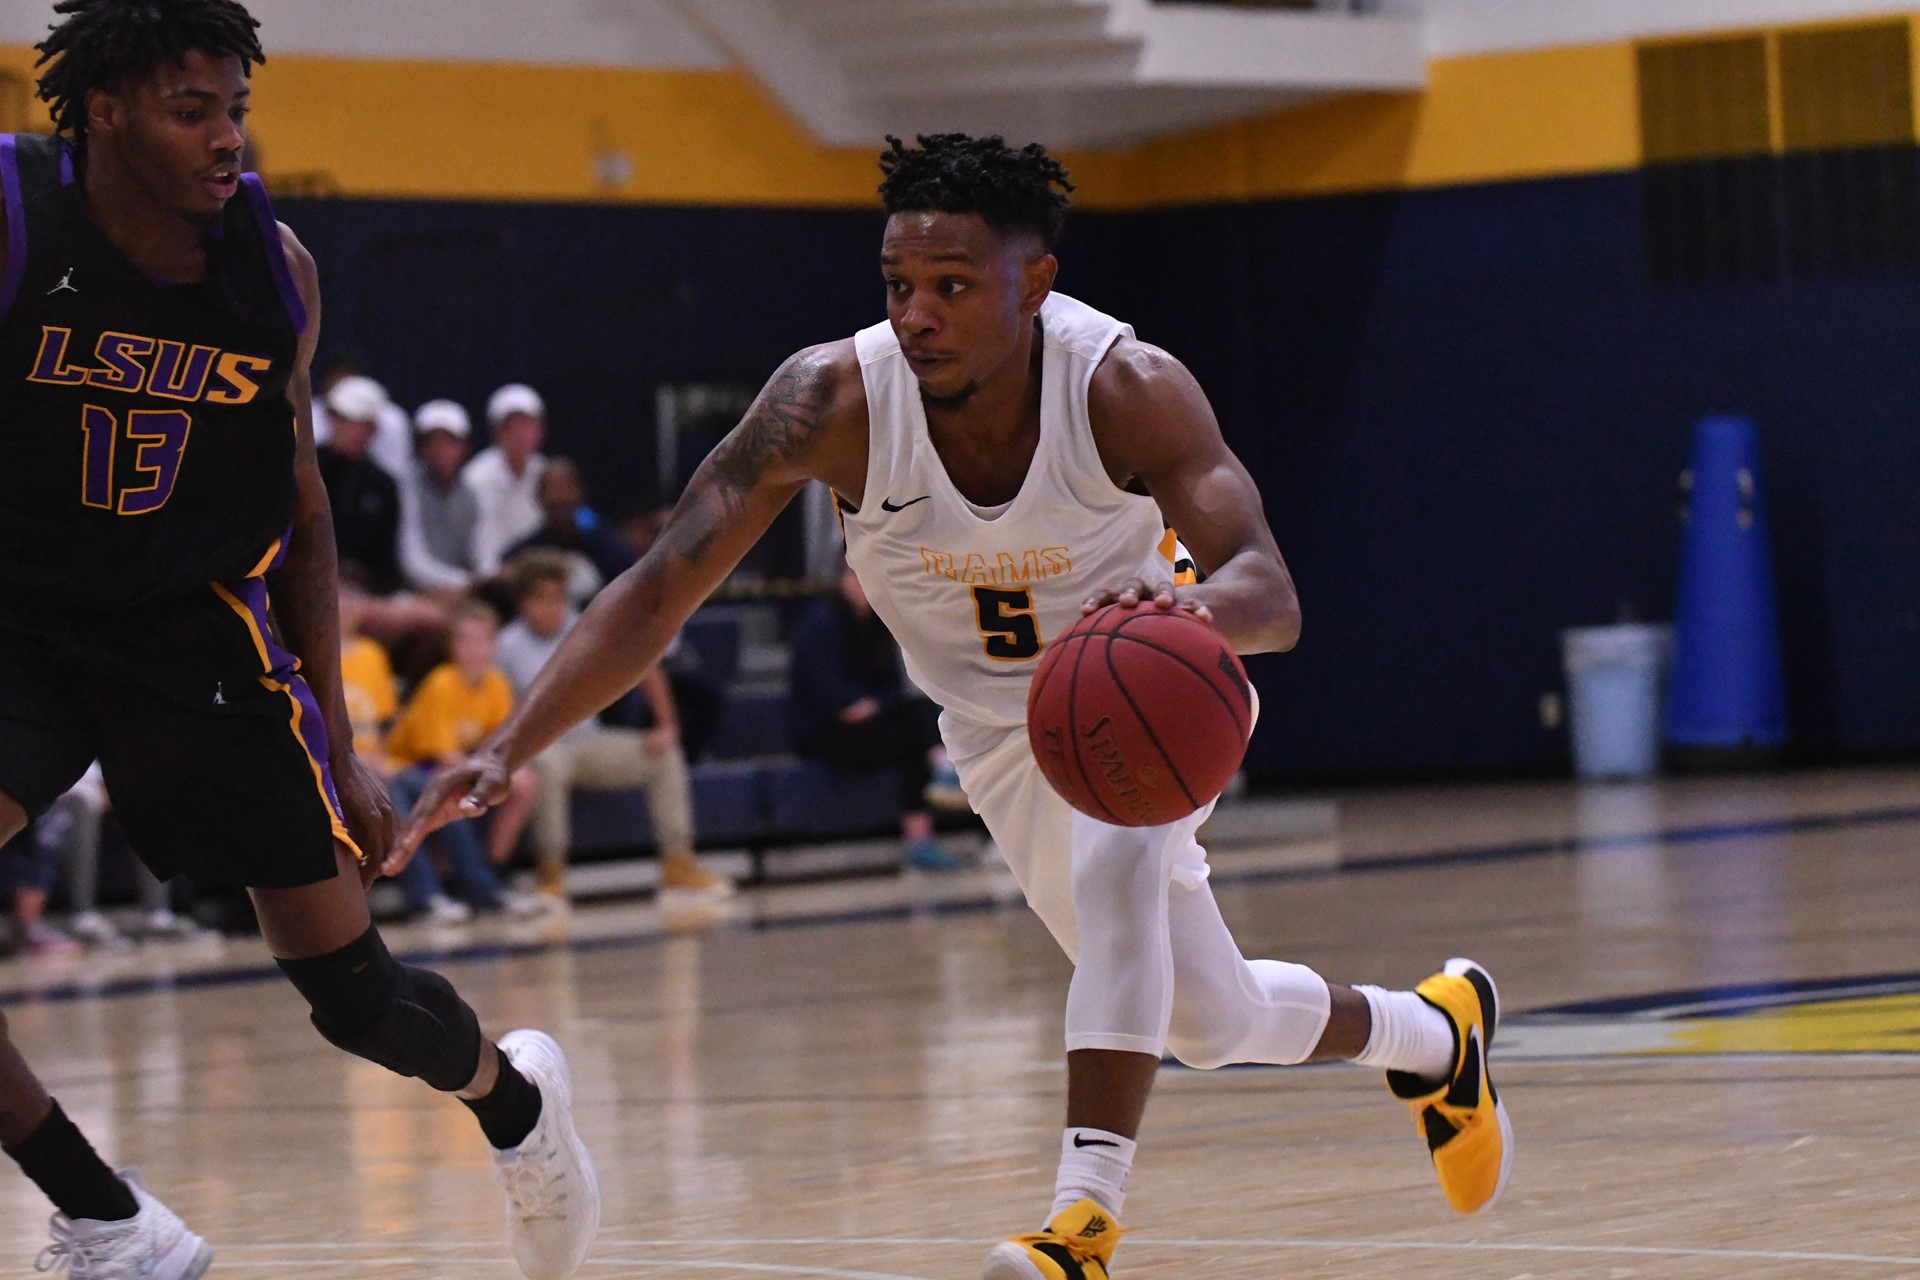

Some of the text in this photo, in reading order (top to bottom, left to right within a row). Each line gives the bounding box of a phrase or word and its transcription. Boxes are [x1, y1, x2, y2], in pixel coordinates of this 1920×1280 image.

[26, 325, 272, 404] LSUS
[82, 404, 192, 515] 13
[920, 546, 1072, 585] RAMS
[970, 585, 1043, 662] 5
